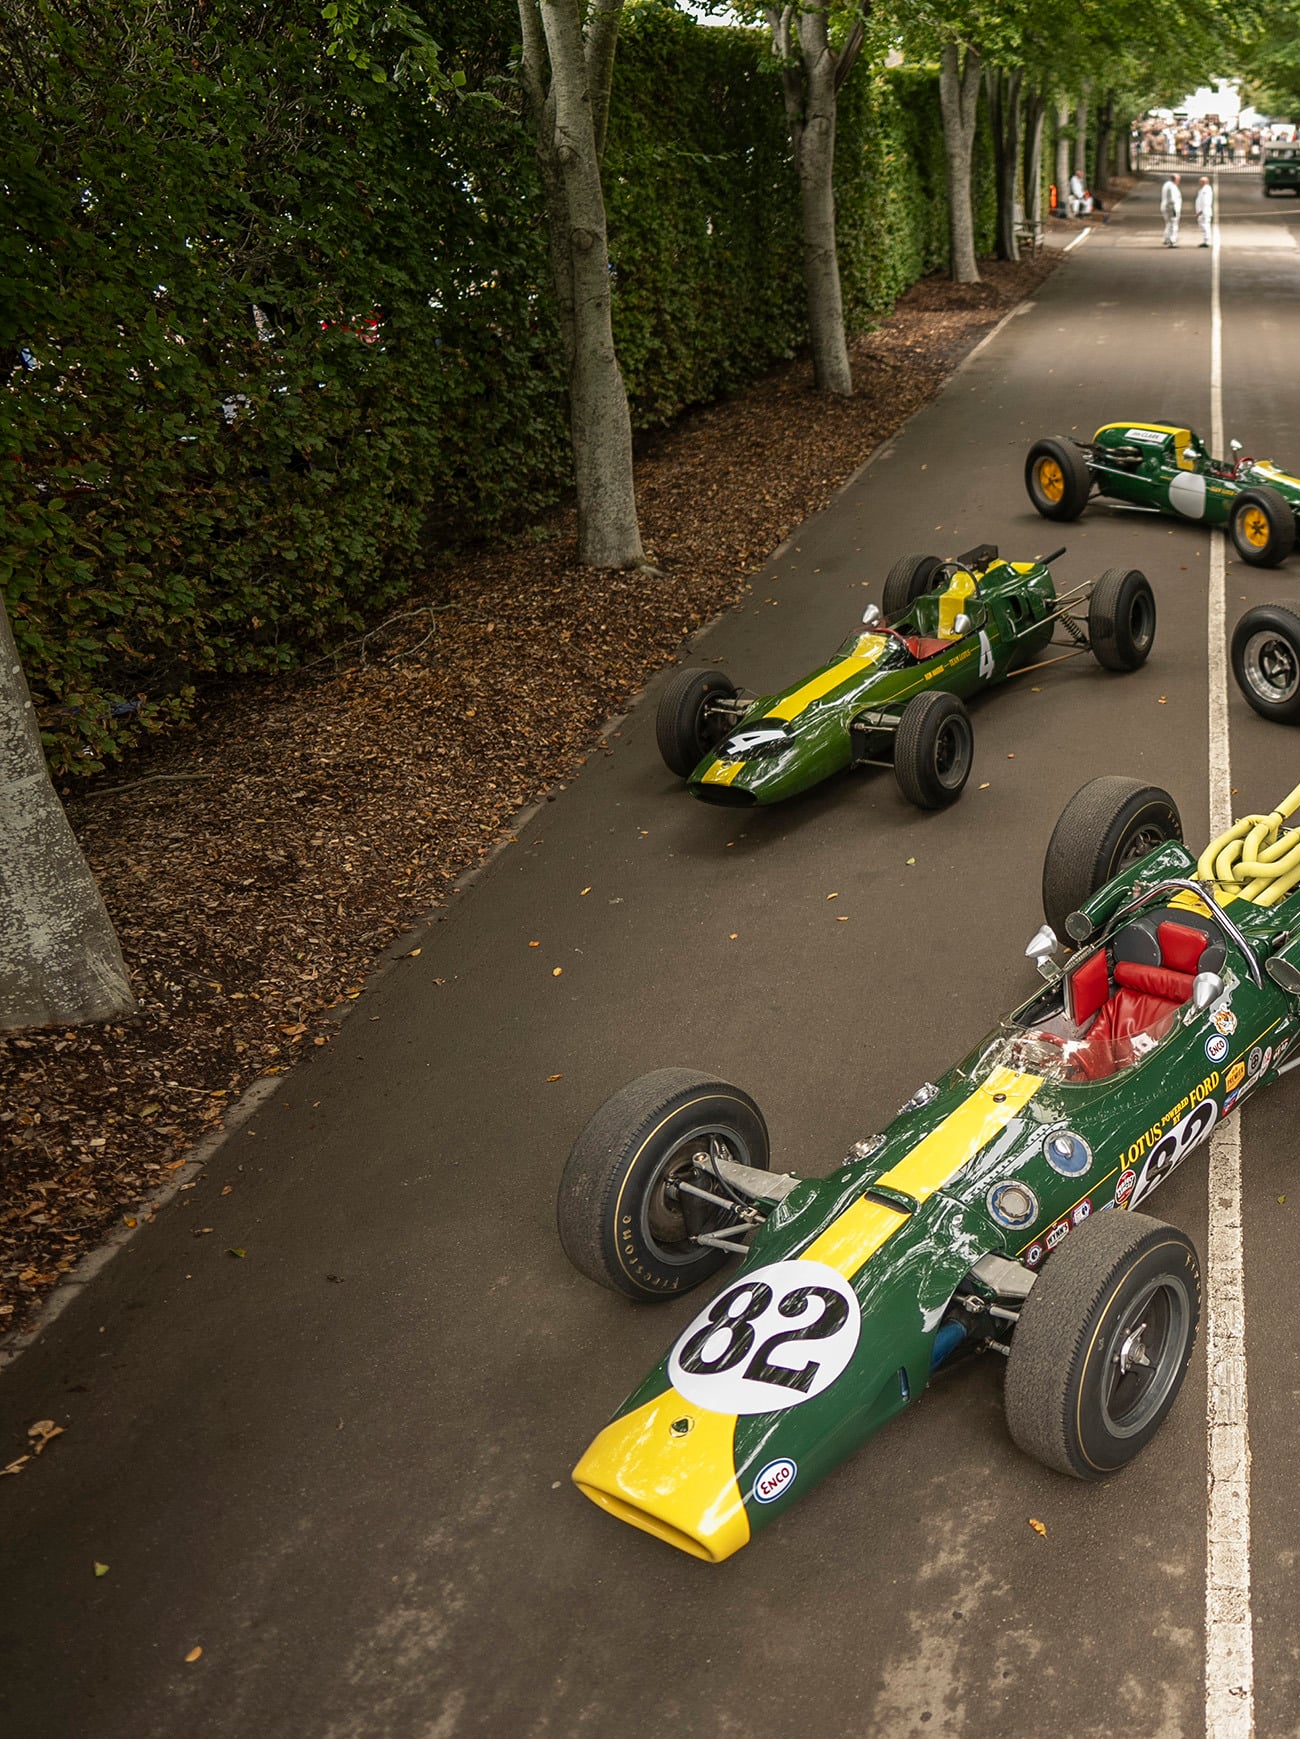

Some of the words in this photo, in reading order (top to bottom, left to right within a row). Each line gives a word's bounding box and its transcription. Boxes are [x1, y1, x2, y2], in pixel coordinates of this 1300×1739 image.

[979, 630, 995, 679] 4
[727, 730, 787, 755] 4
[1189, 1071, 1220, 1109] FORD
[1161, 1097, 1189, 1126] POWERED
[1172, 1112, 1182, 1126] BY
[1119, 1122, 1163, 1172] LOTUS
[678, 1281, 850, 1394] 82
[760, 1467, 790, 1496] ENCO
